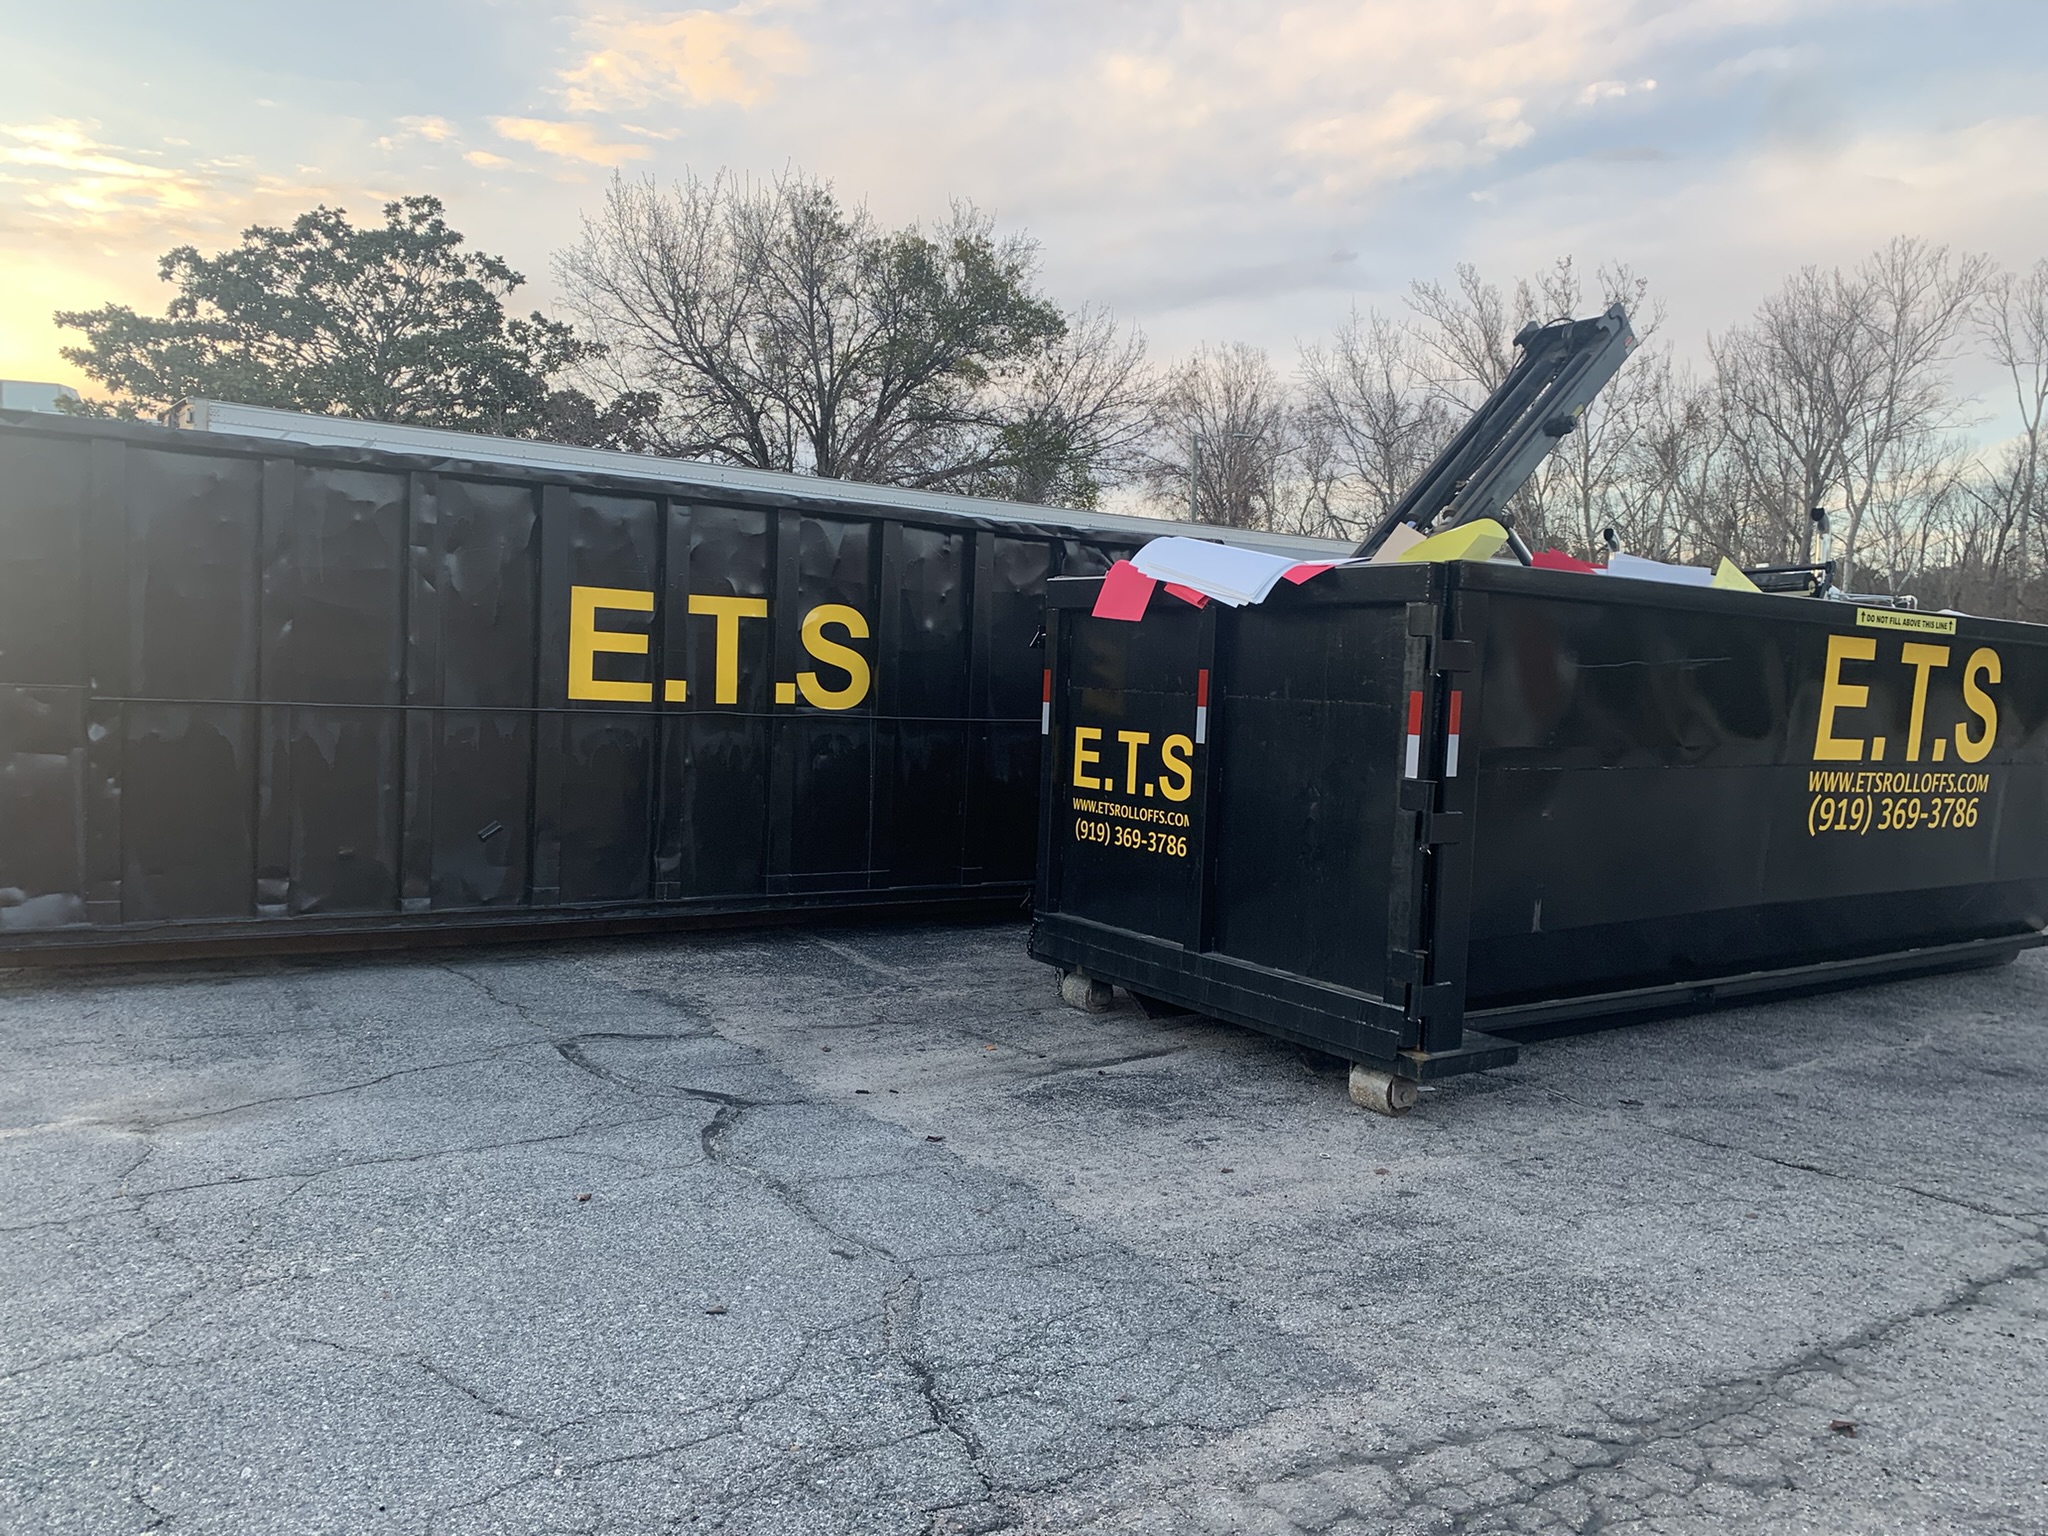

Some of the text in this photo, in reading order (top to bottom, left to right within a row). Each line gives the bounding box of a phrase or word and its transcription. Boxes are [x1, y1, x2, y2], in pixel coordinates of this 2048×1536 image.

[1867, 614, 1948, 630] DO NOT FILL ABOVE THIS LINE
[567, 585, 870, 711] E.T.S
[1813, 634, 2002, 764] E.T.S
[1073, 726, 1194, 802] E.T.S
[1808, 771, 1989, 793] WWW.ETSROLLOFFS.COM
[1808, 794, 1980, 837] (919) 369-3786
[1075, 817, 1187, 858] (919) 369-3786
